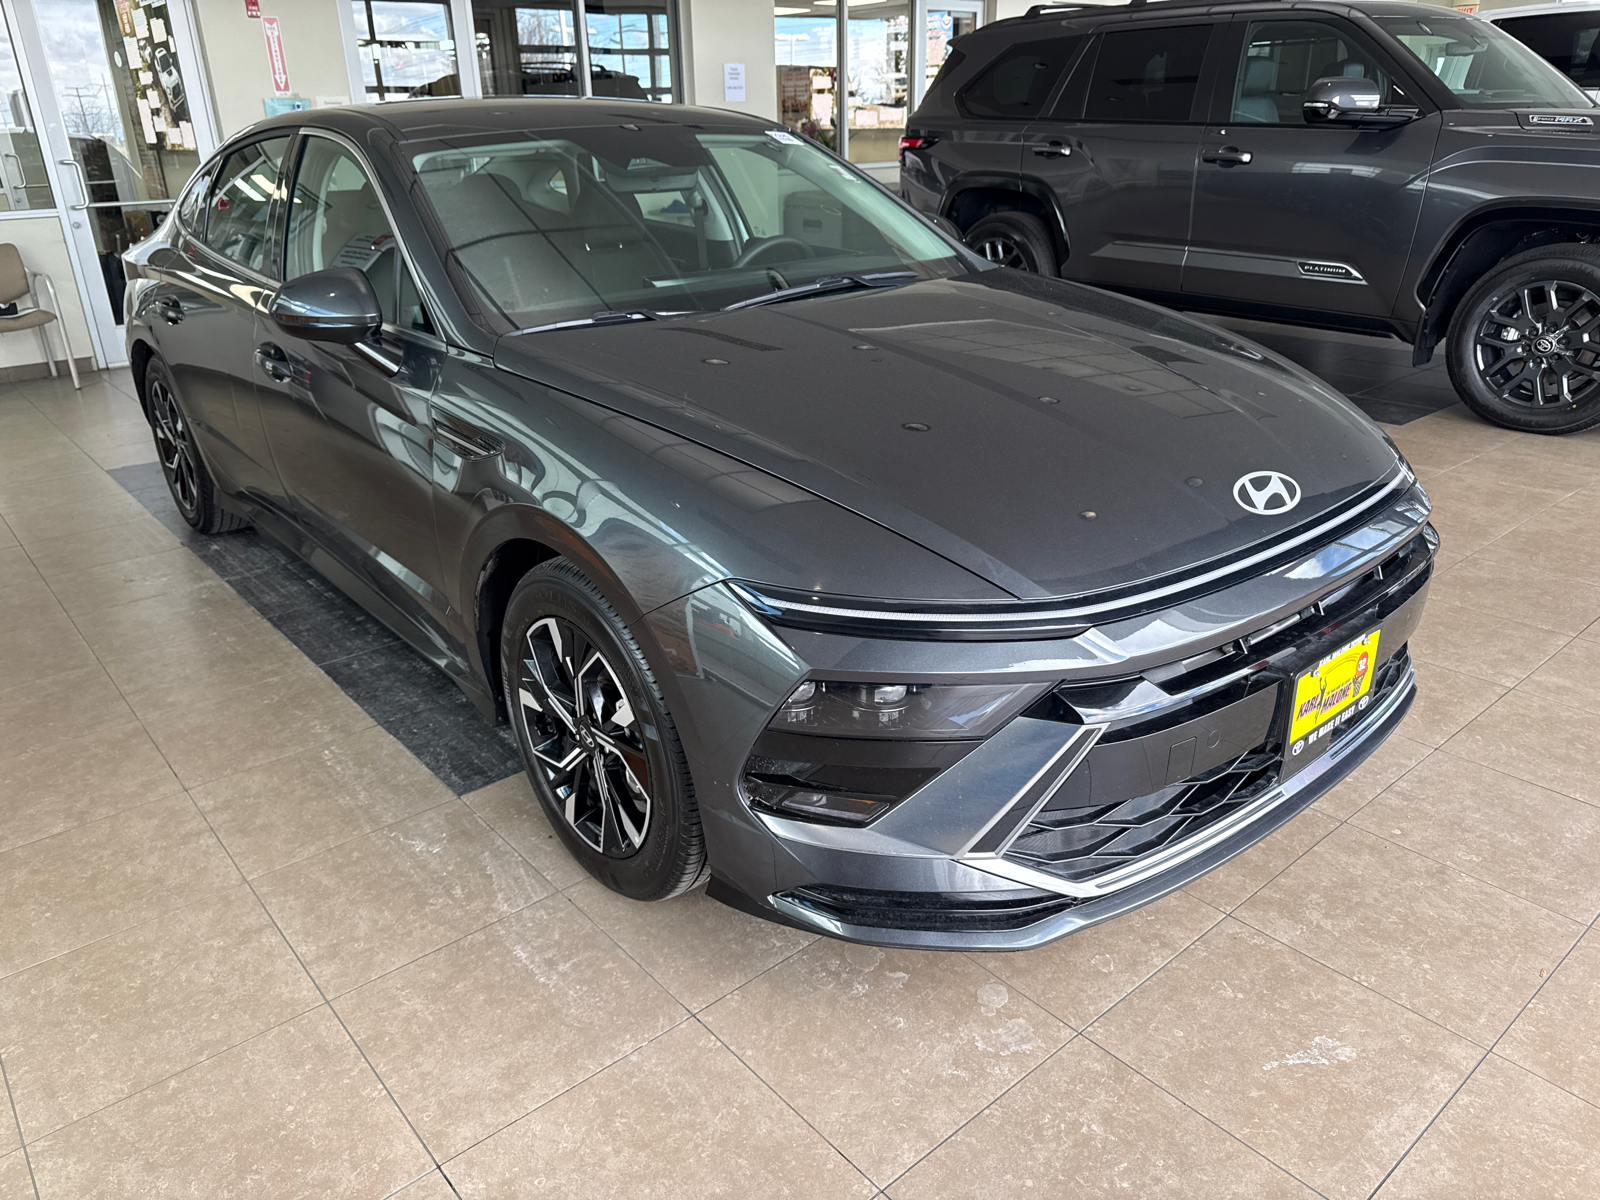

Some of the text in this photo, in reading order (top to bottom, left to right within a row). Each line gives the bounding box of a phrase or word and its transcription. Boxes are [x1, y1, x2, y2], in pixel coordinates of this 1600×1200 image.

[1304, 265, 1346, 274] PLATINUM
[1358, 657, 1367, 672] 32
[1308, 705, 1356, 745] WE MAKE IT EASY
